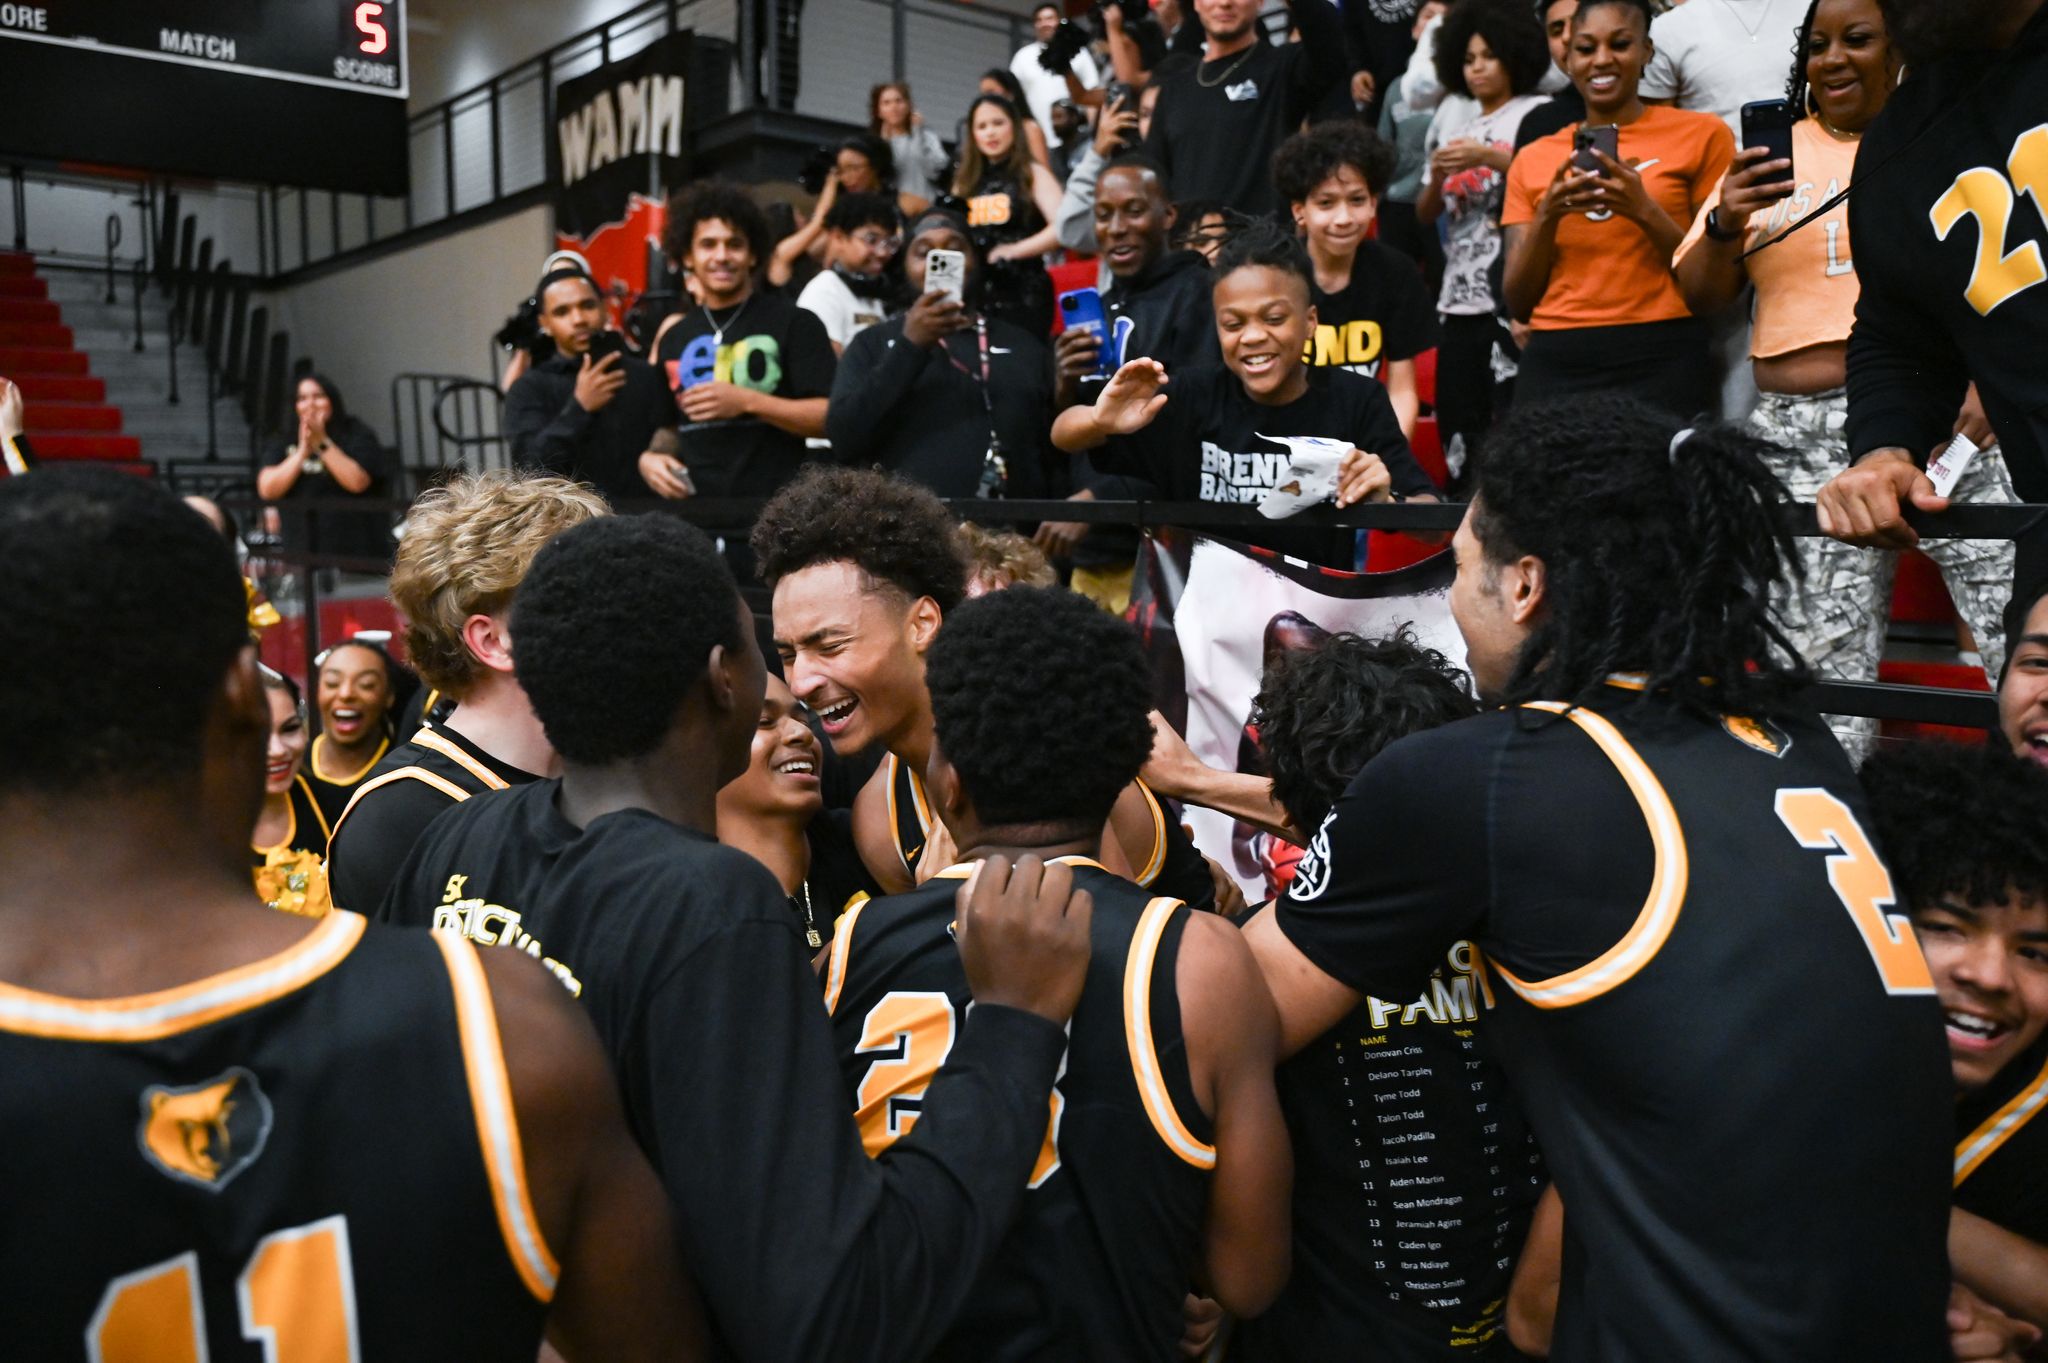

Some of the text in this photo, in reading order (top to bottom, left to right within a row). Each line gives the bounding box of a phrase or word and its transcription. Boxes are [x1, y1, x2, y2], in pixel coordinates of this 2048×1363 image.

[354, 2, 388, 54] 5
[159, 28, 236, 61] MATCH
[333, 56, 397, 87] SCORE
[558, 73, 684, 189] WAMM
[1774, 787, 1938, 996] 2
[1360, 1035, 1388, 1046] NAME
[1364, 1049, 1402, 1060] Donovan
[1344, 1077, 1350, 1086] 2
[1347, 1099, 1354, 1107] 3
[1374, 1093, 1397, 1103] Tyme
[1398, 1088, 1421, 1099] Todd
[1402, 1110, 1425, 1120] Todd
[1354, 1139, 1361, 1147] 5
[1382, 1134, 1407, 1145] Jacob
[1407, 1131, 1436, 1142] Padilla
[1359, 1159, 1371, 1168] 10
[1385, 1156, 1411, 1165] Isaiah
[1413, 1154, 1429, 1164] Lee
[1363, 1181, 1374, 1190] 11
[1389, 1178, 1415, 1188] Aiden
[1415, 1175, 1445, 1185] Martin
[1367, 1199, 1378, 1207] 12
[1393, 1200, 1416, 1209] Sean
[1369, 1219, 1381, 1228] 13
[1372, 1239, 1383, 1247] 14
[1398, 1240, 1427, 1249] Caden
[1374, 1260, 1386, 1269] 15
